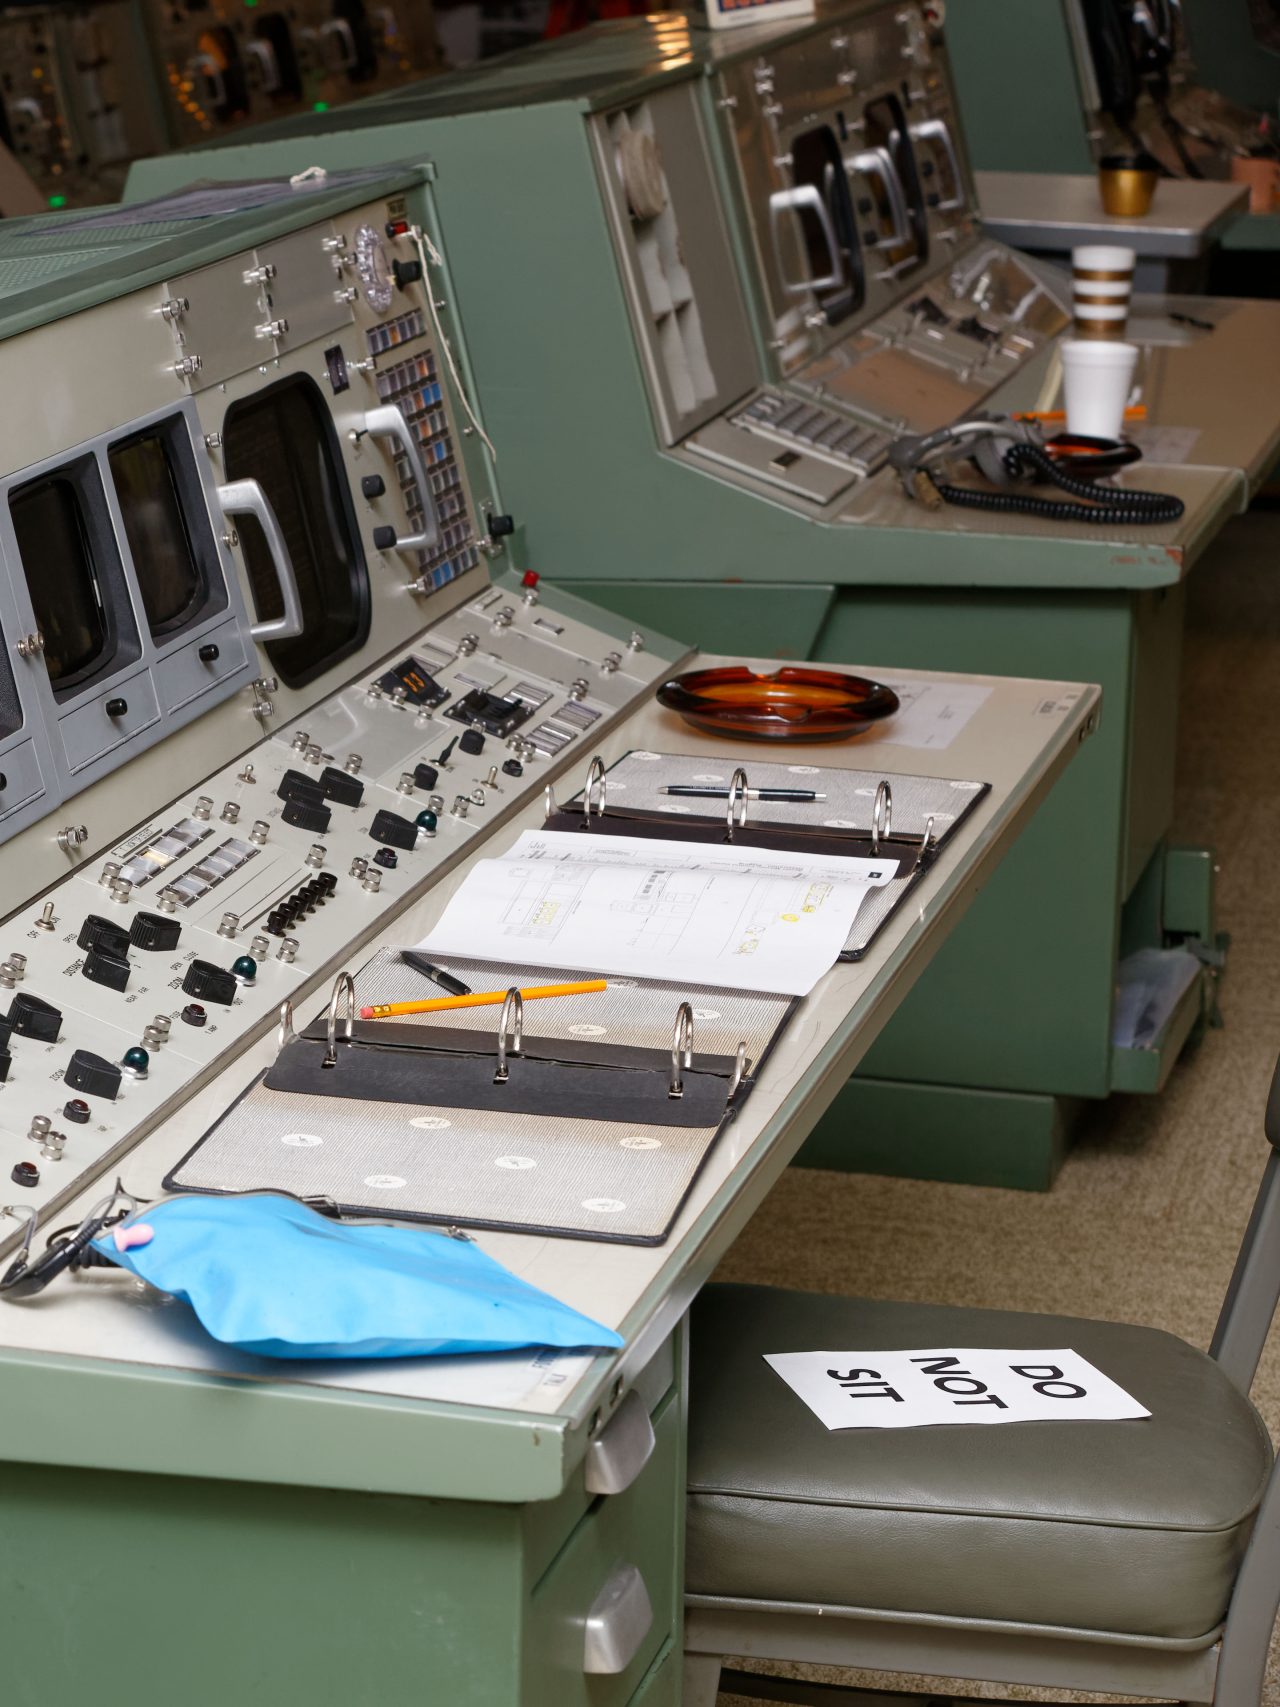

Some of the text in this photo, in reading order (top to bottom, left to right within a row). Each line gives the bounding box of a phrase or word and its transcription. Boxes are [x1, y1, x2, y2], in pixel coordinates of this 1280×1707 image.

[827, 1368, 905, 1403] SIT
[909, 1357, 1009, 1409] NOT
[1009, 1365, 1087, 1399] DO
